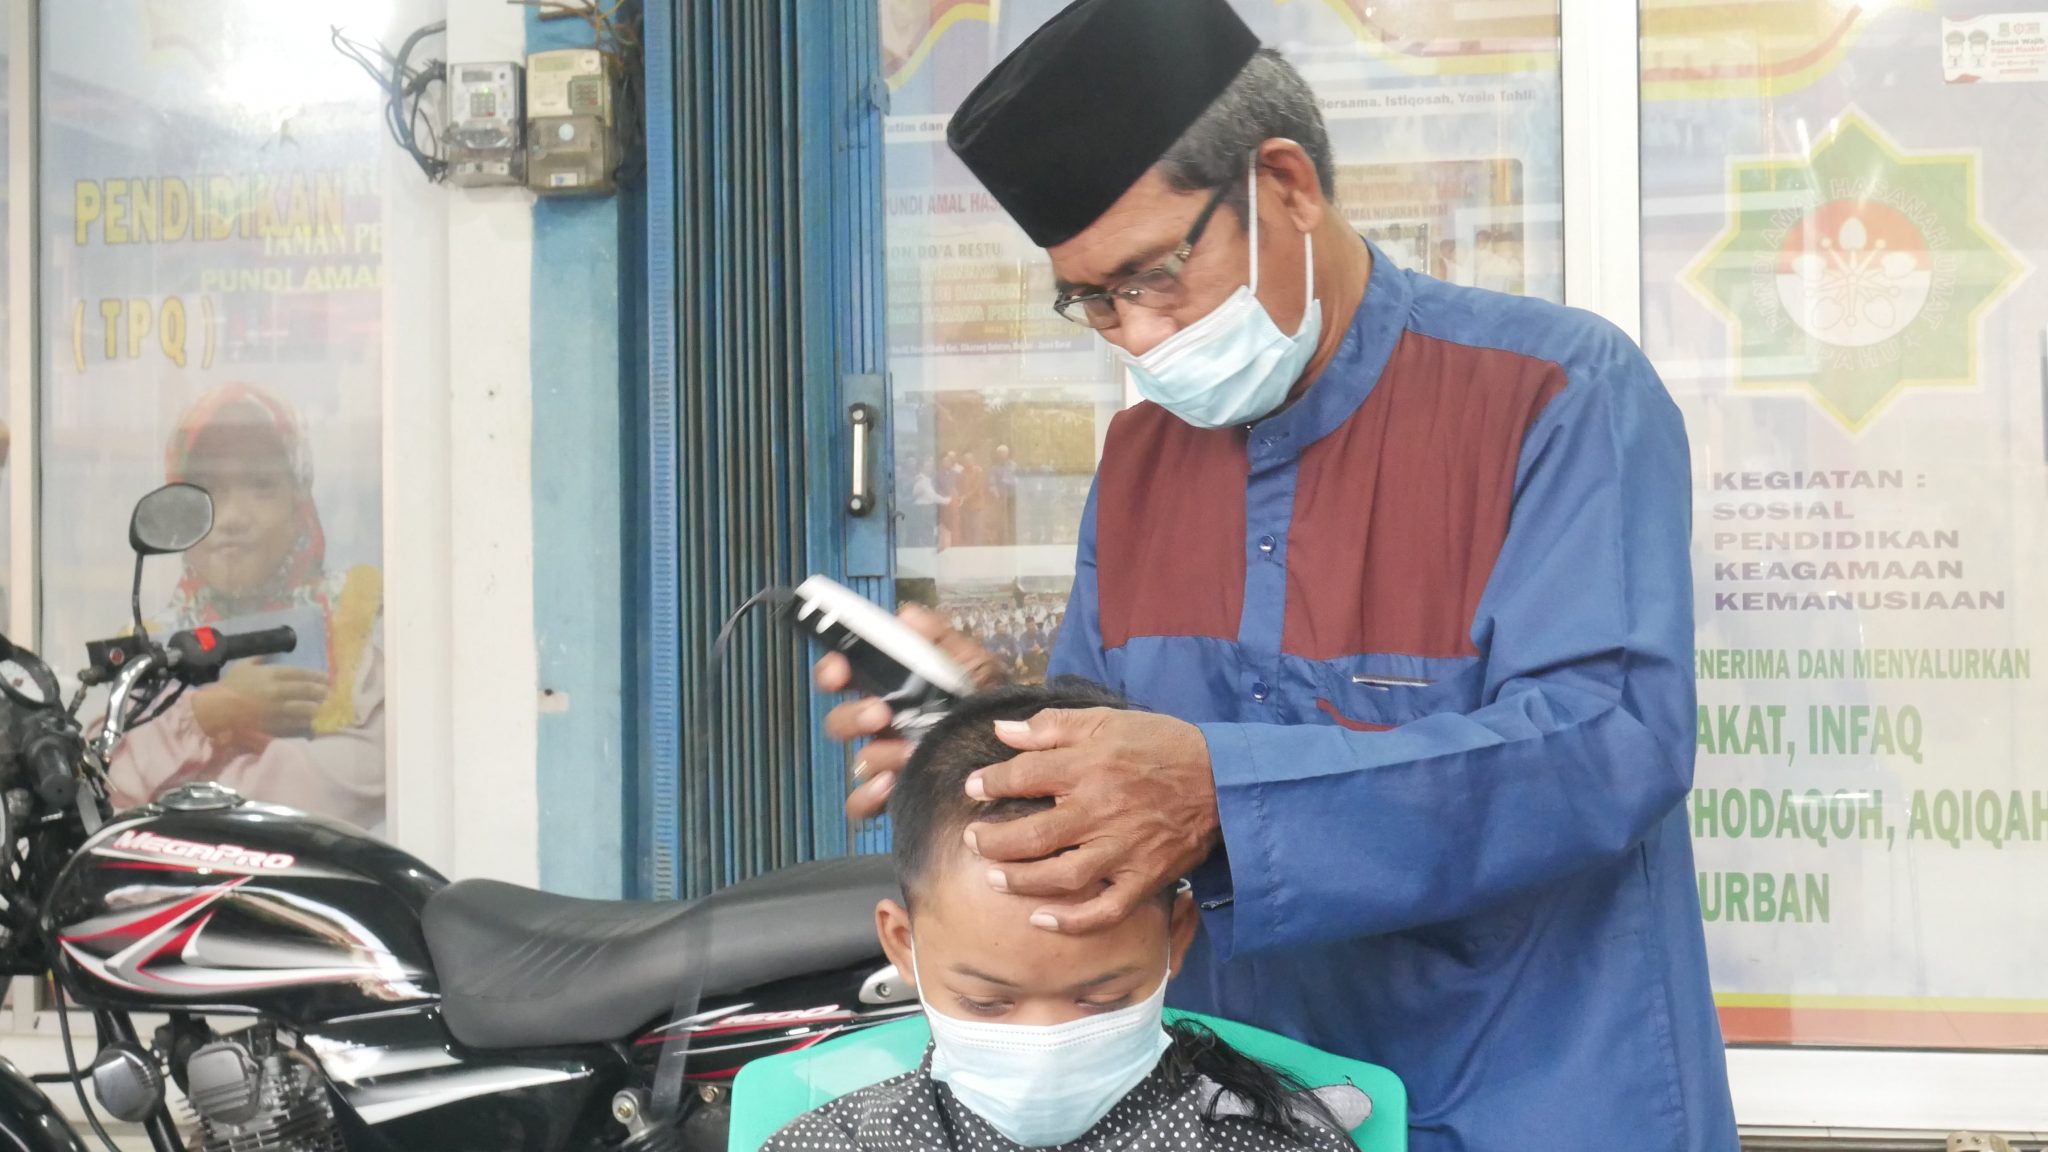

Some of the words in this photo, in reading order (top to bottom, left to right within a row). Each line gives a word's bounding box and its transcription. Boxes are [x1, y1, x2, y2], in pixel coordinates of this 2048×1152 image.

[74, 171, 347, 246] PENDIDIKAN
[886, 194, 923, 216] UNDI
[1713, 470, 1903, 491] KEGIATAN
[1712, 501, 1854, 521] SOSIAL
[1714, 530, 1959, 551] PENDIDIKAN
[1714, 560, 1963, 581] KEAGAMAAN
[1714, 590, 2005, 612] KEMANUSIAAN
[1799, 648, 1845, 680] DAN
[1853, 648, 2031, 680] MENYALURKAN
[1808, 705, 1924, 765] INFAQ
[1692, 787, 1896, 852] HODAQOH,
[1907, 788, 2048, 850] AQIQAH
[1698, 871, 1831, 924] URBAN
